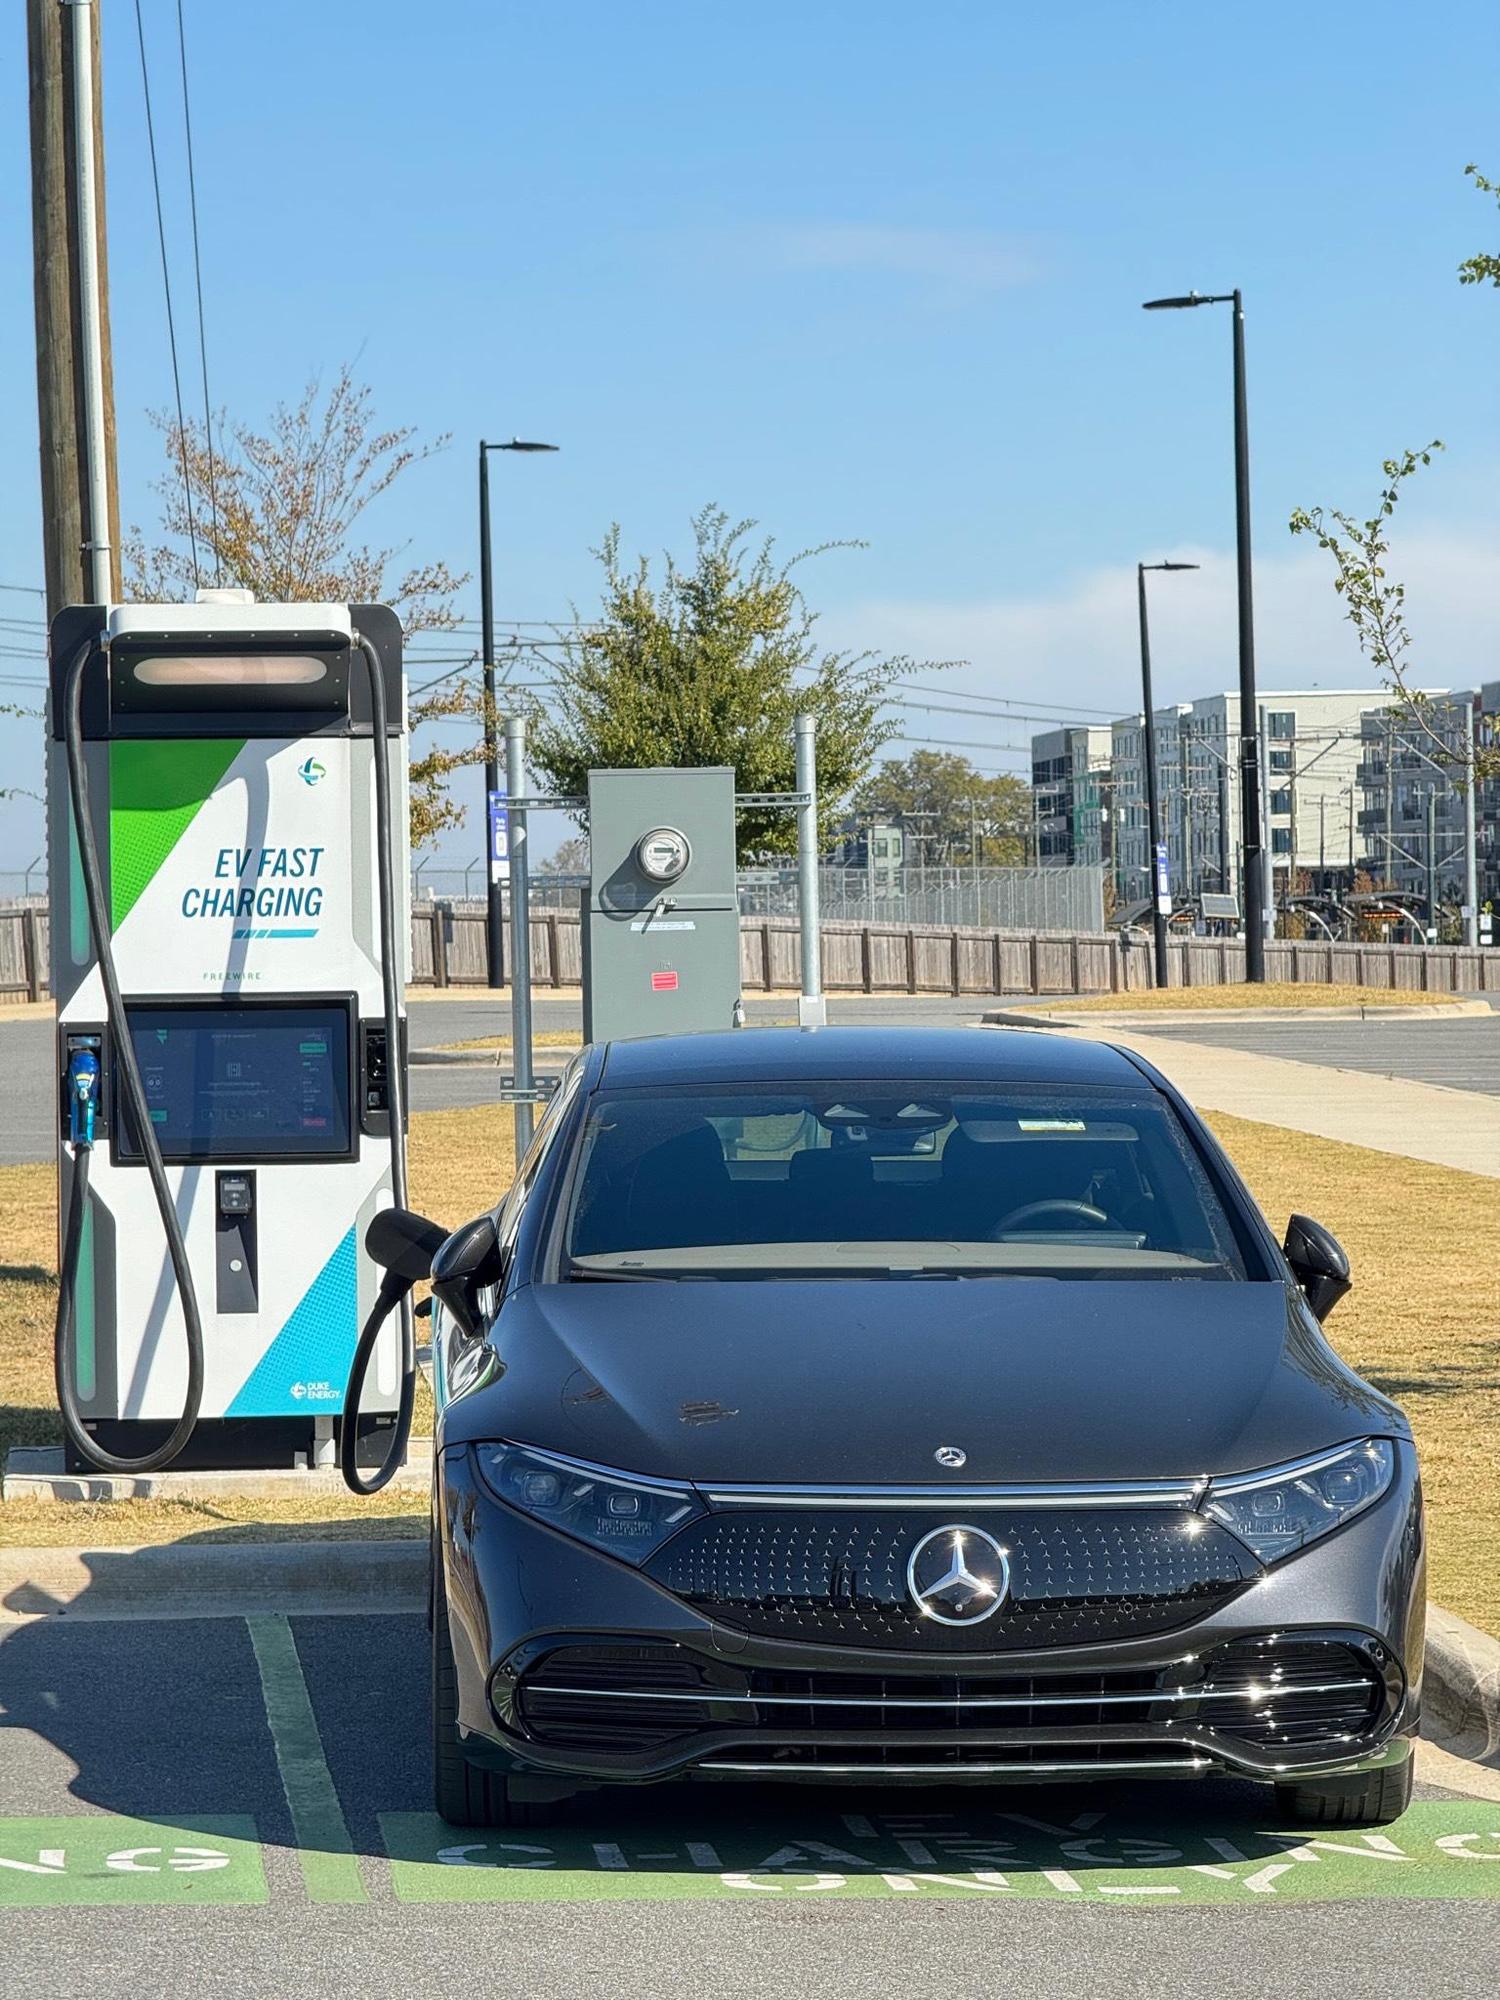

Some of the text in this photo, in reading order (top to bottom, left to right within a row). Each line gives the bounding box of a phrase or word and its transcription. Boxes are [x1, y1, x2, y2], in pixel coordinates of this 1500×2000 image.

[214, 847, 325, 878] EV FAST
[181, 887, 324, 918] CHARGING
[203, 972, 262, 980] FREEWIRE
[307, 1382, 330, 1391] DUKE
[307, 1390, 341, 1400] ENERGY
[719, 1864, 1295, 1894] ONLY
